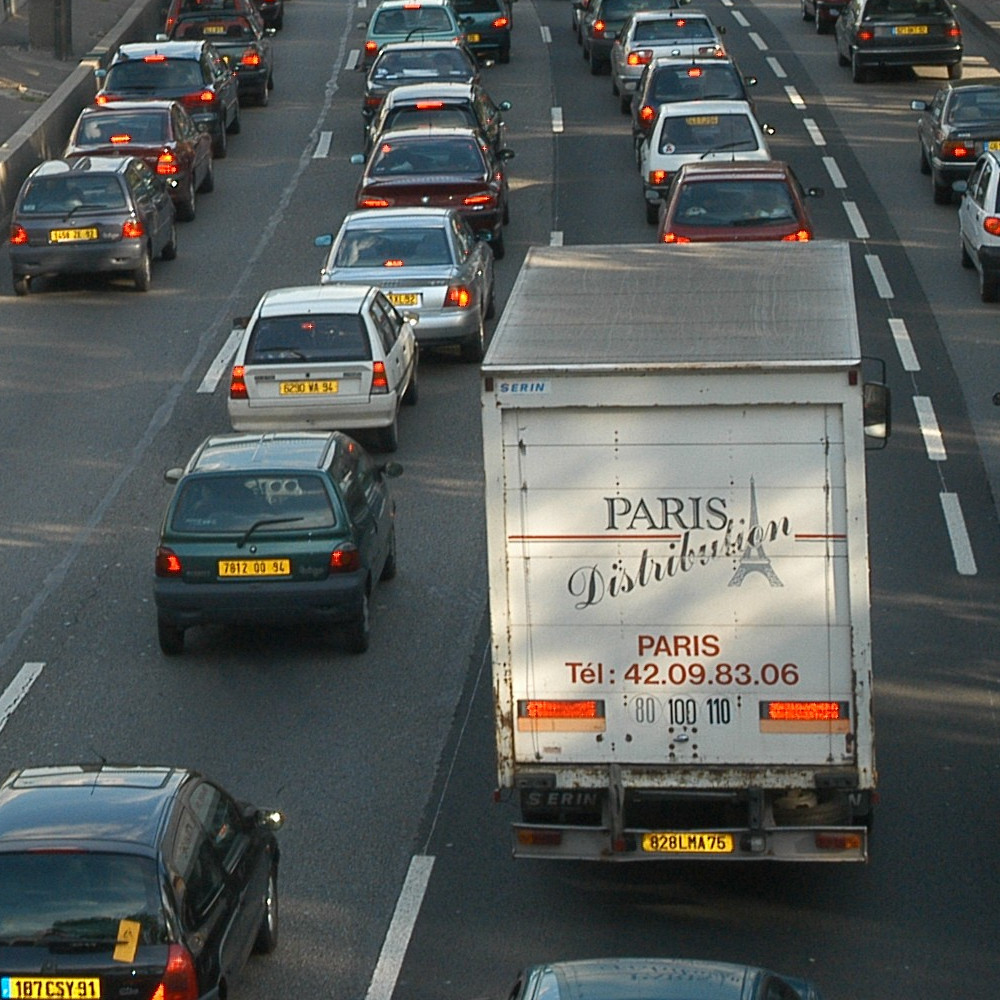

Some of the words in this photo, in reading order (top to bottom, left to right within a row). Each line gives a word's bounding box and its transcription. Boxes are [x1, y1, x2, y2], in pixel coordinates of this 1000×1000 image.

[500, 383, 545, 392] SERIN
[603, 497, 727, 530] PARIS
[223, 562, 248, 574] 7812
[272, 561, 285, 572] 94
[568, 515, 791, 610] Distribution
[637, 635, 721, 657] PARIS
[624, 663, 799, 686] 42.09.83.06
[635, 697, 655, 724] 80
[668, 698, 697, 725] 100
[706, 698, 731, 725] 110
[528, 792, 598, 806] SERIN
